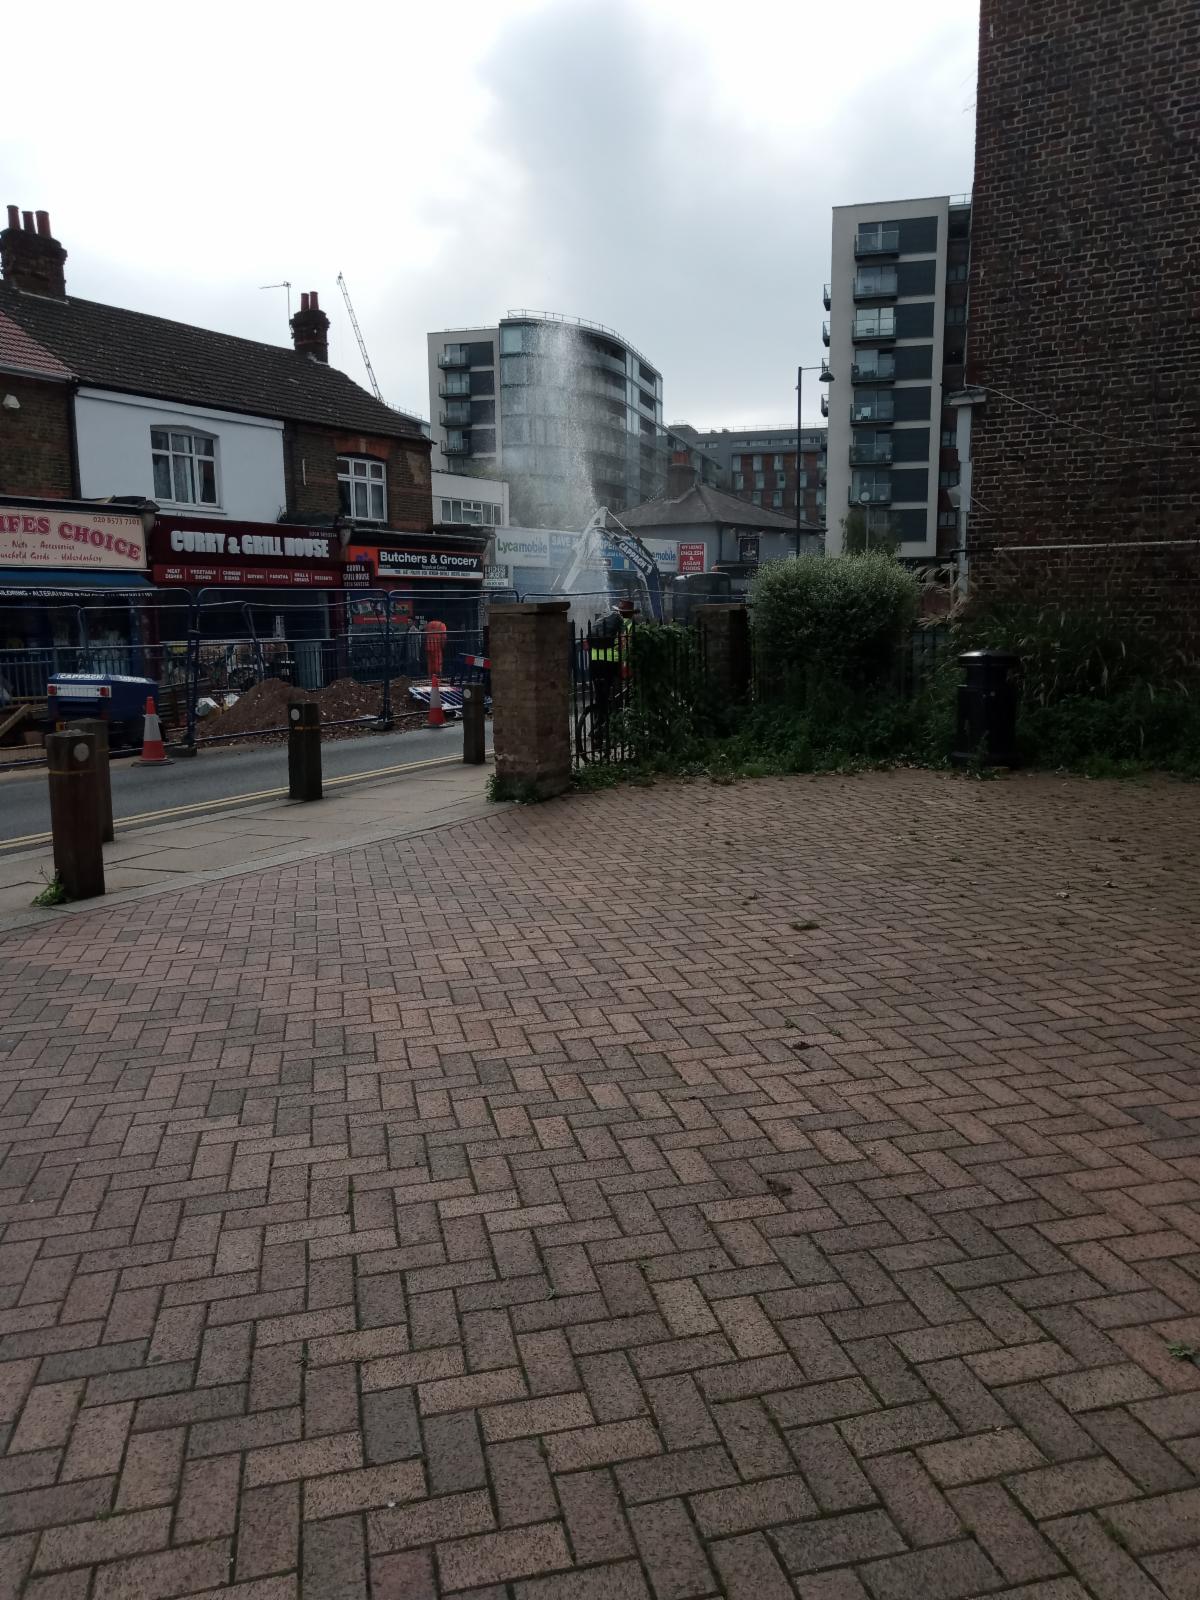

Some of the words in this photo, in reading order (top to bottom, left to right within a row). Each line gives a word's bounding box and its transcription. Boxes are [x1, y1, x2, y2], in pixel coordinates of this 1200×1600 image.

[58, 522, 141, 561] CHOICE
[170, 530, 226, 554] CURRY
[228, 536, 241, 555] &
[242, 534, 284, 557] GRILL
[283, 537, 330, 558] HOUSE
[497, 538, 548, 554] Lycamobile
[31, 552, 50, 561] Goods
[379, 551, 427, 565] Butchers
[430, 553, 438, 565] &
[440, 555, 478, 568] Grocery
